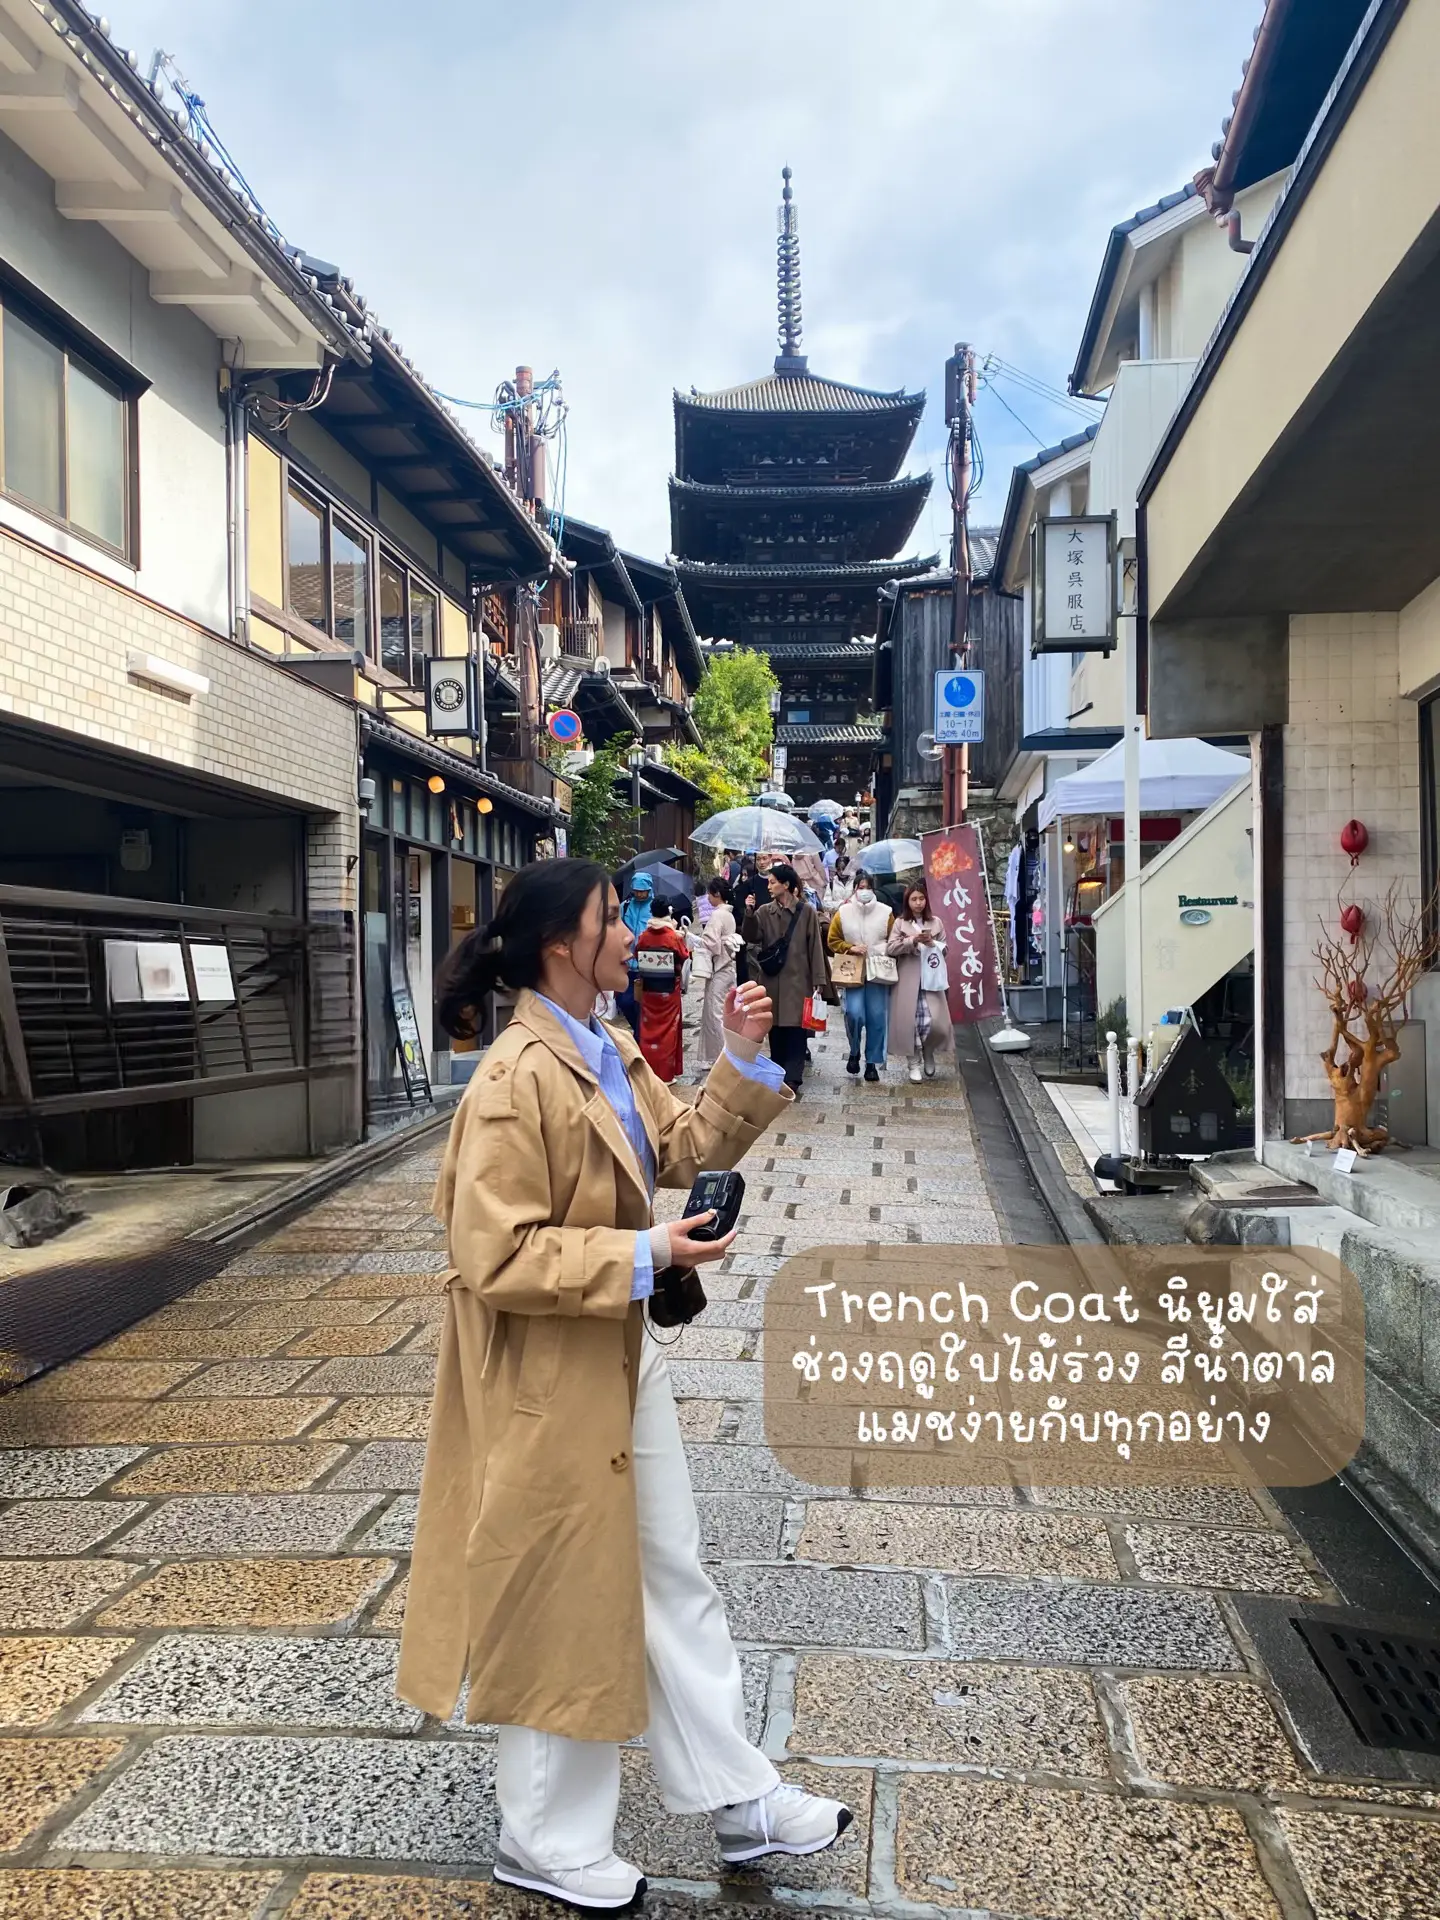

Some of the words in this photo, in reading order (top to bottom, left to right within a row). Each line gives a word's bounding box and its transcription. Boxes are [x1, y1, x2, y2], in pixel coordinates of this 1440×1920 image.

[1067, 528, 1085, 631] 大塚呉服店
[961, 729, 980, 738] 40m
[1178, 895, 1239, 908] Restaurant
